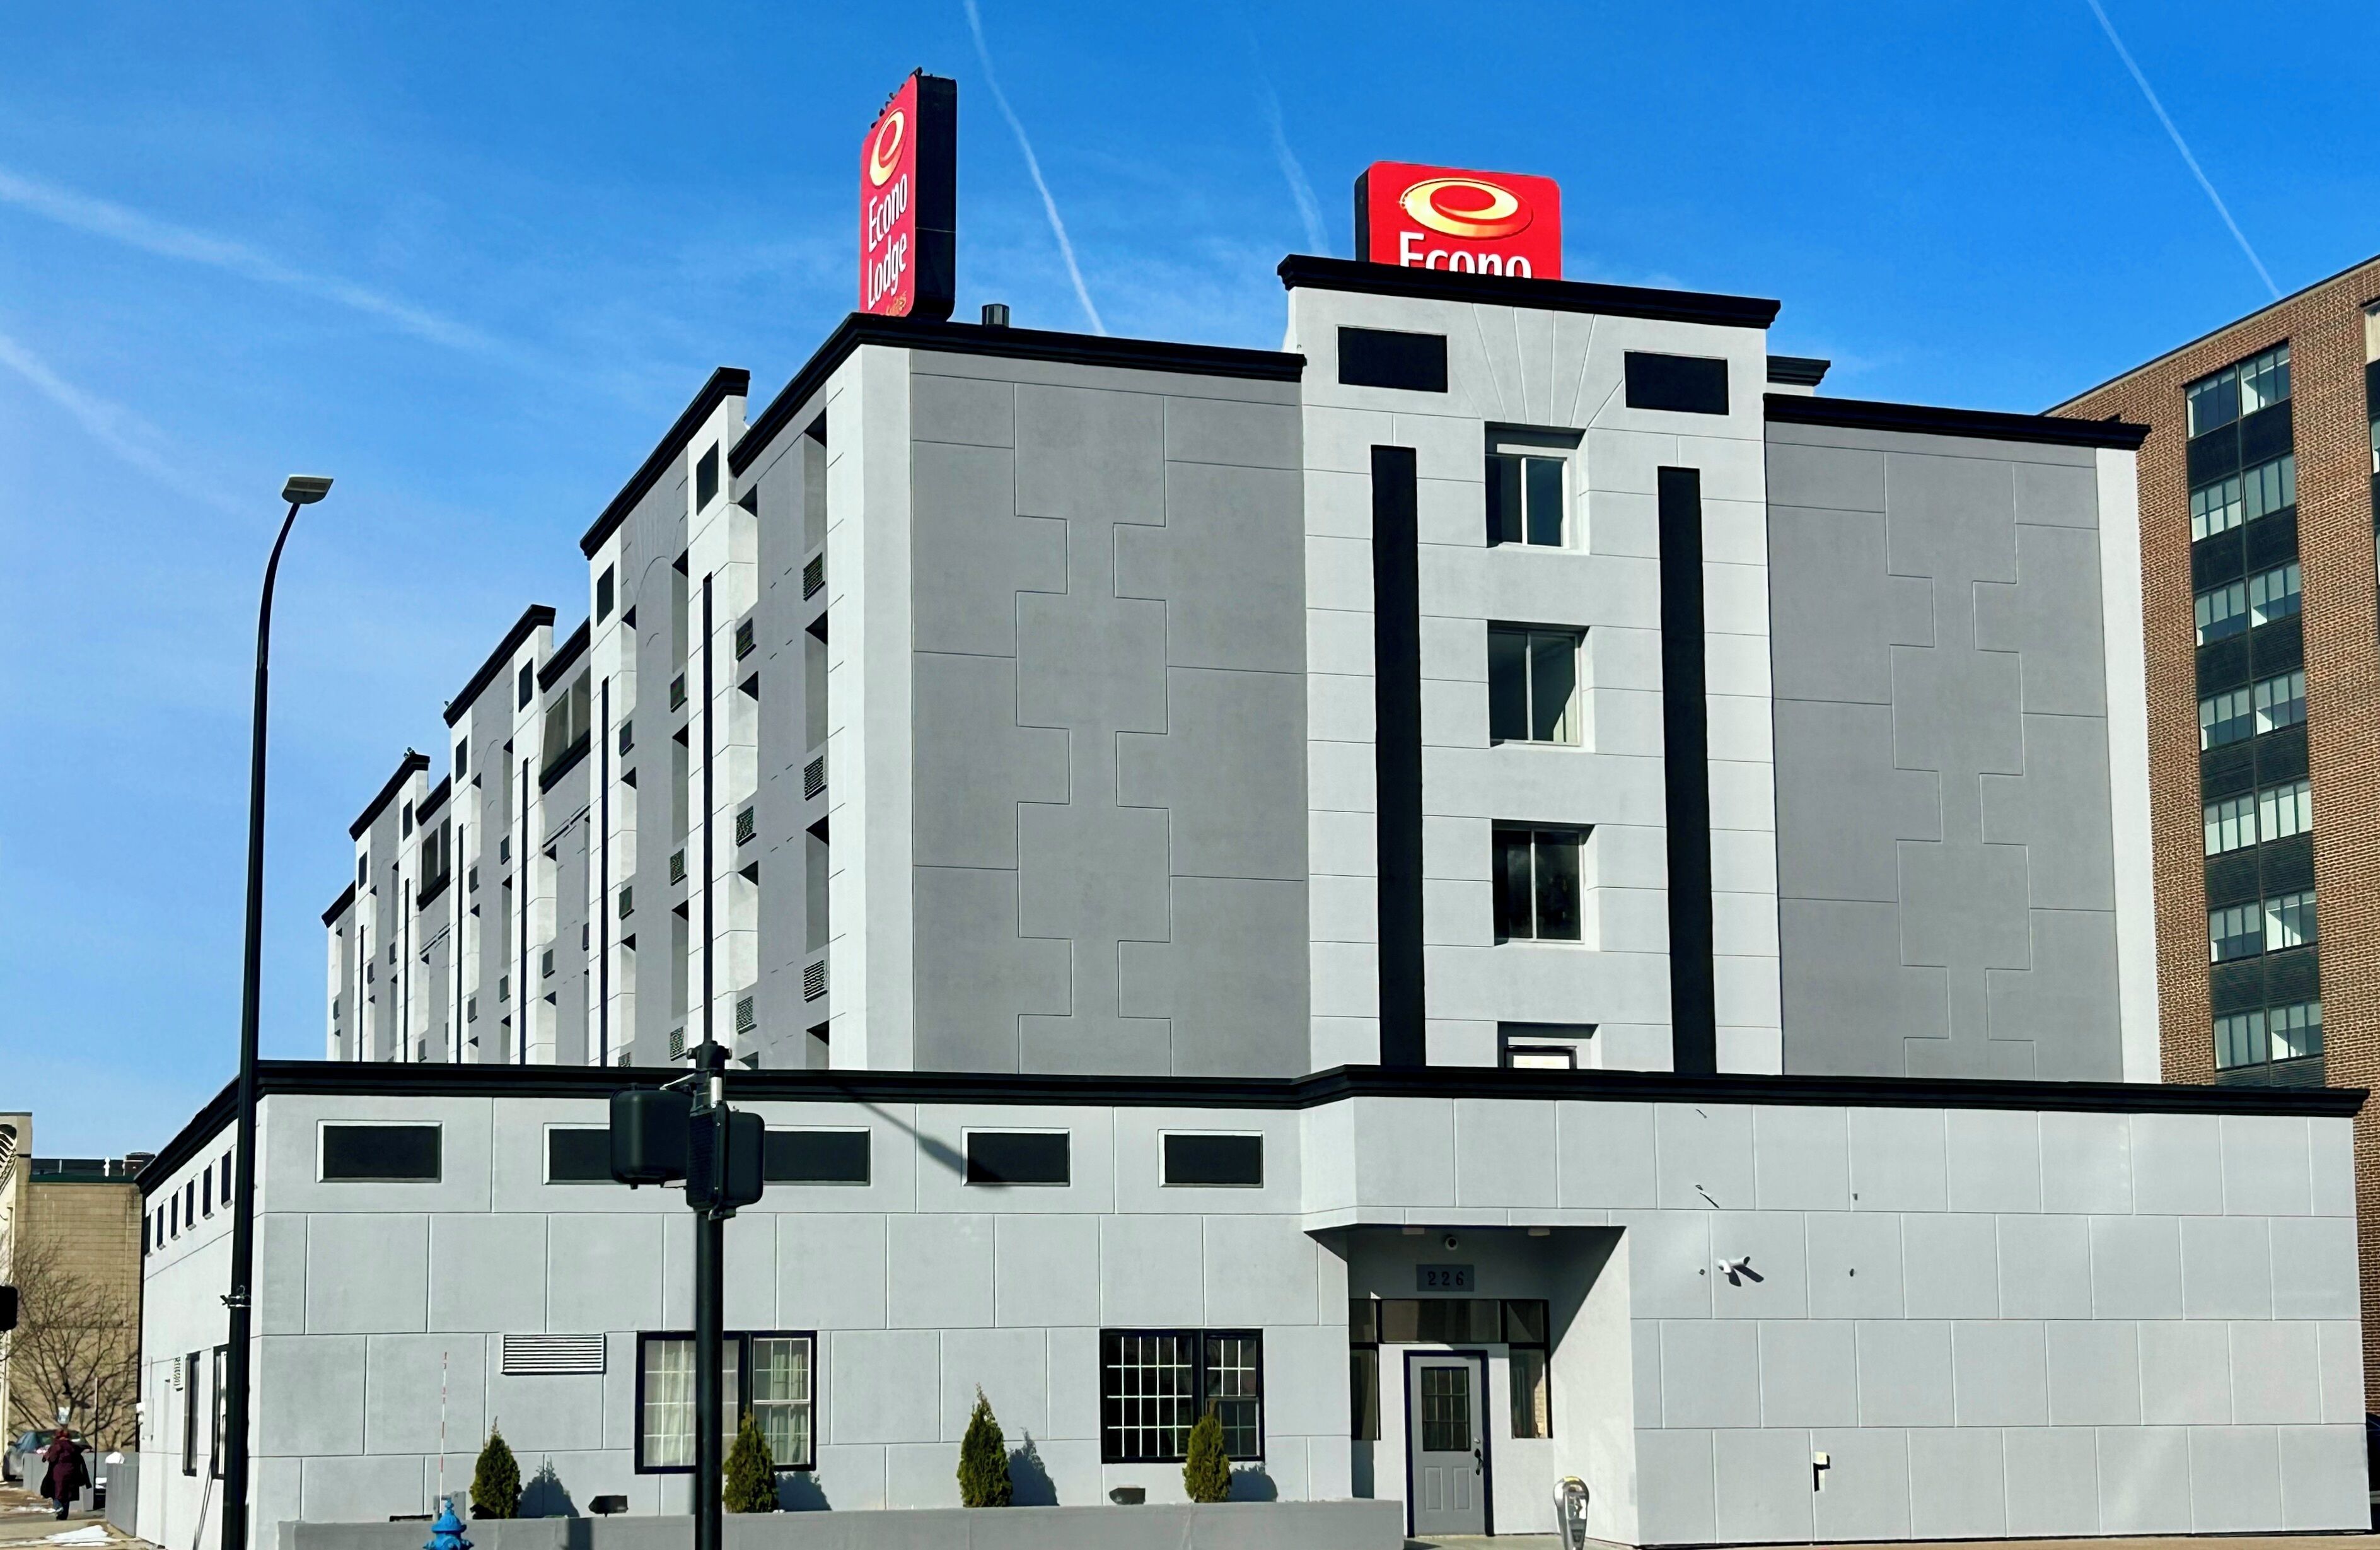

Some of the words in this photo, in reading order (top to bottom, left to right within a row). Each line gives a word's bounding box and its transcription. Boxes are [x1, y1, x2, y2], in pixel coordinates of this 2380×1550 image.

[868, 173, 908, 253] Econo
[868, 232, 907, 311] Lodge
[1400, 231, 1532, 279] Econo
[1427, 1271, 1465, 1286] 226
